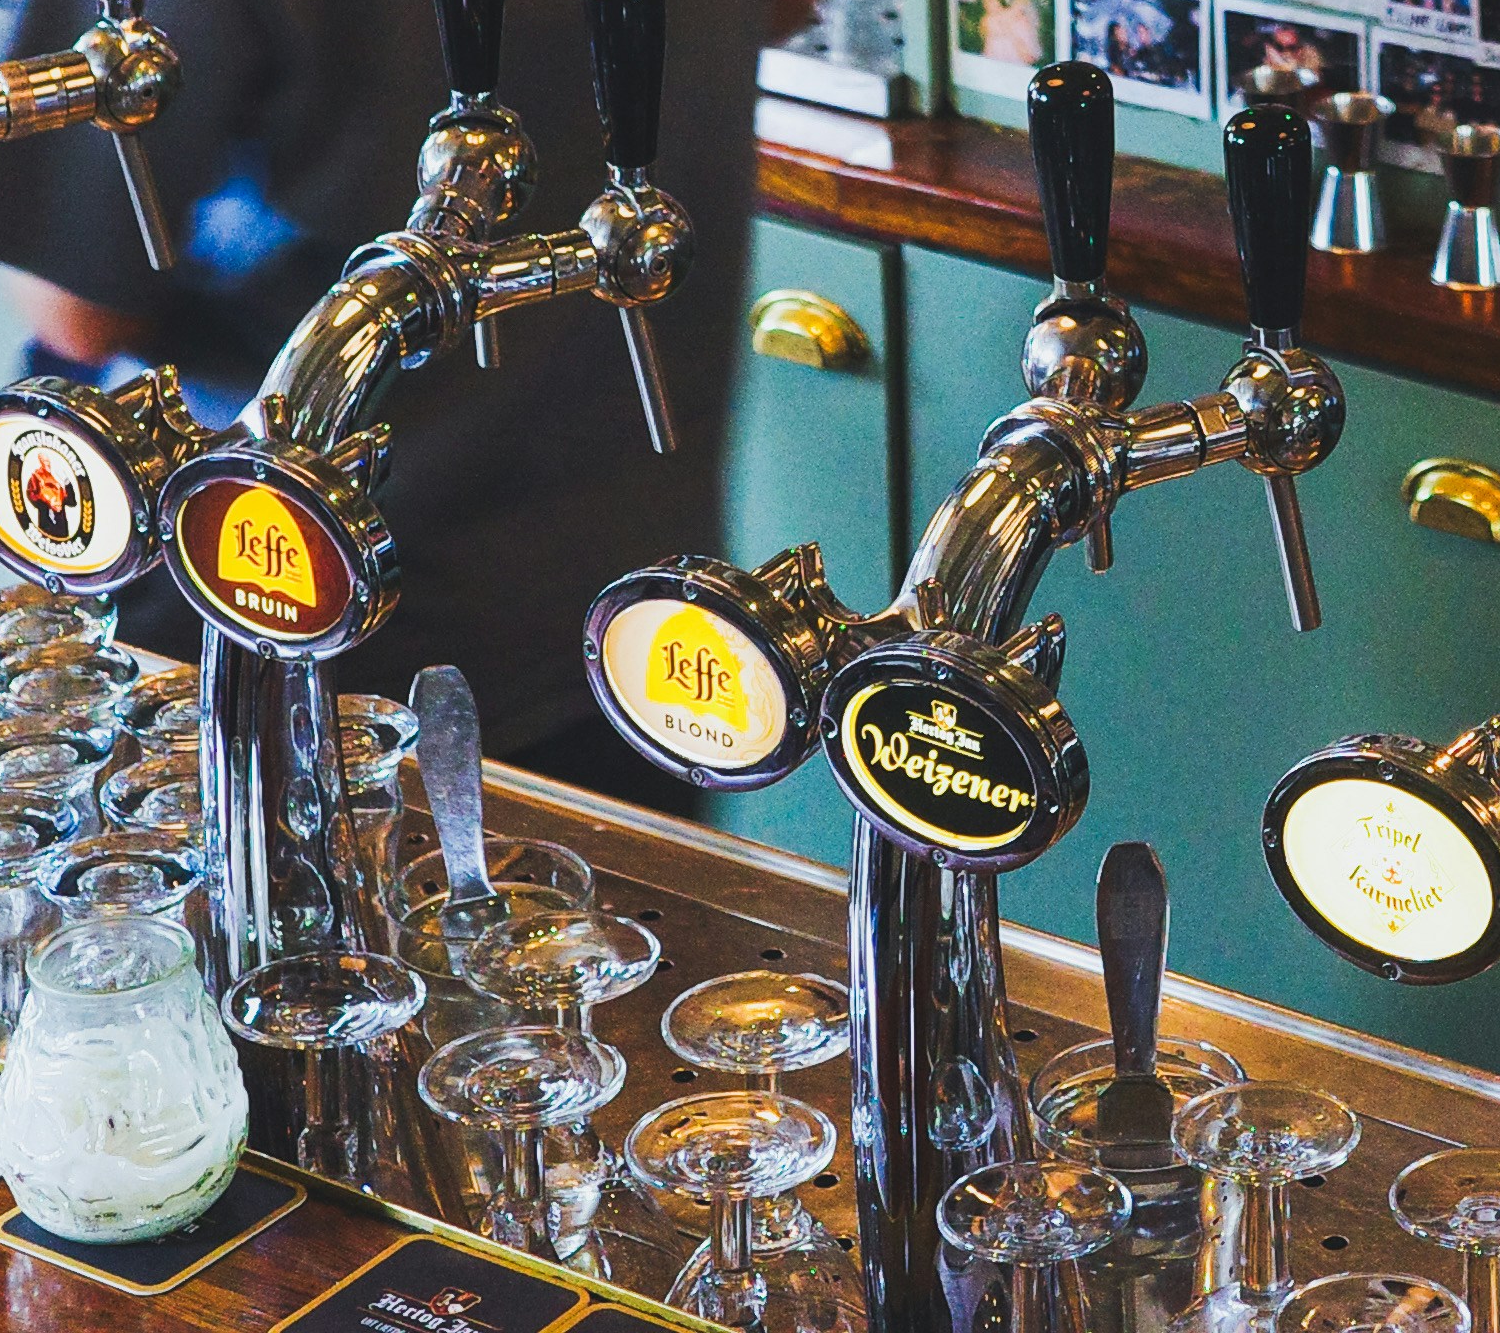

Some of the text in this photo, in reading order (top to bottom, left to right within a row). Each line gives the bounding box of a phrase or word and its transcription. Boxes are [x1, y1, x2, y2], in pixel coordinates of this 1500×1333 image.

[232, 519, 301, 580] Leffe
[234, 586, 300, 624] BRUIN
[659, 639, 734, 702] Leffe
[663, 713, 736, 750] BLOND
[908, 715, 984, 754] Hertog Jan
[860, 722, 1033, 816] Weizener
[1356, 815, 1425, 855] Tripel
[1346, 863, 1445, 914] Karmeliet
[367, 1292, 448, 1331] Hertog
